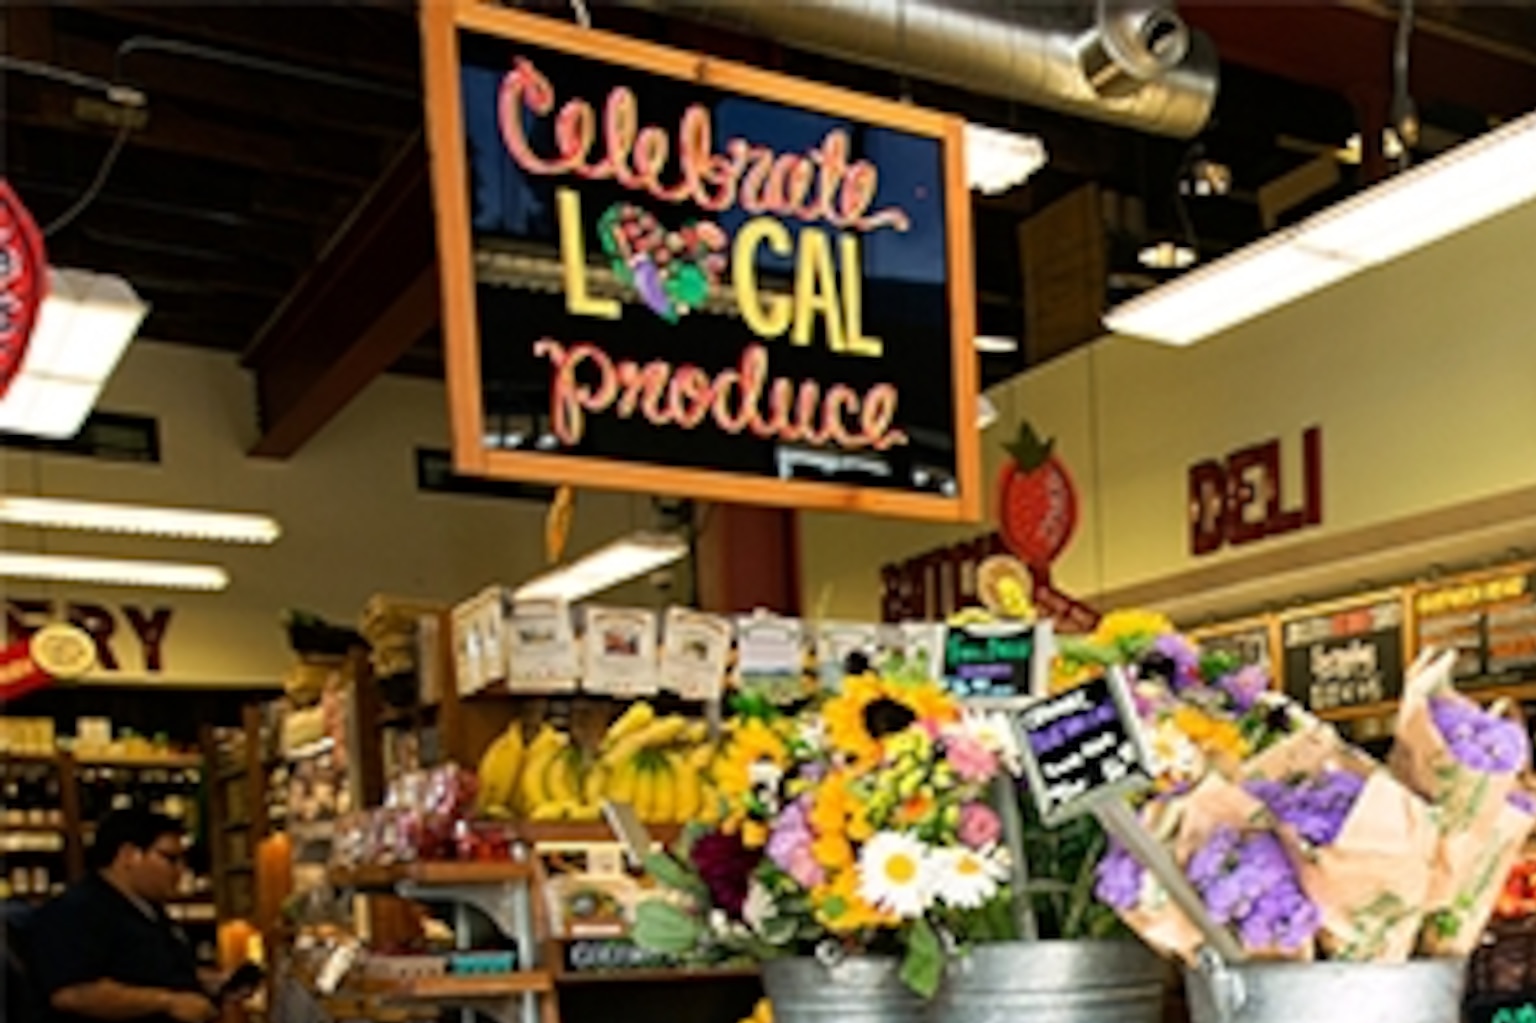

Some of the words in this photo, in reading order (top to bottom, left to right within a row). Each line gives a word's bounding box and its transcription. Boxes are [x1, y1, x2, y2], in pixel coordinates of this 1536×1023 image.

[498, 56, 909, 232] Celebrate
[556, 187, 884, 357] LCAL
[1189, 425, 1322, 557] DELI
